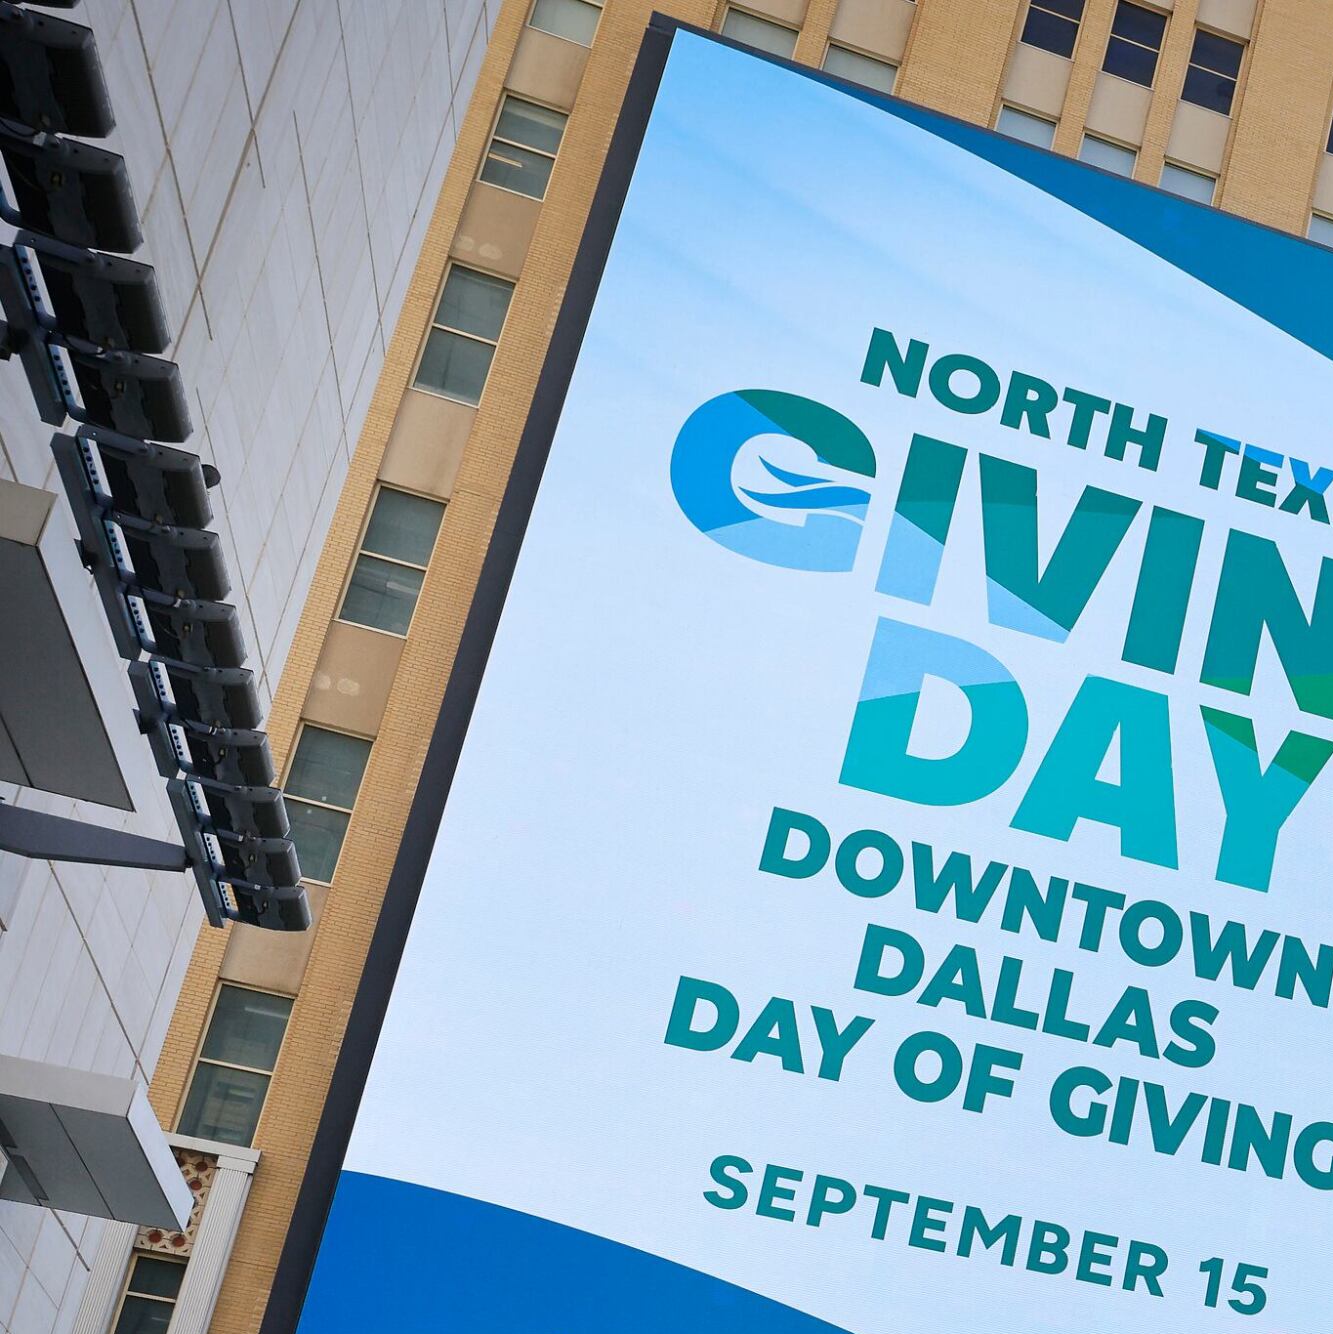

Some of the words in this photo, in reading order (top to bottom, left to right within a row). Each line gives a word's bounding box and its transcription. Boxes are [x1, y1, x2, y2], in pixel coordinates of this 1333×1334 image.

[860, 327, 1168, 471] NORTH
[663, 975, 876, 1082] DAY
[893, 1031, 1025, 1113] OF
[853, 923, 1220, 1068] DALLAS
[703, 1154, 1170, 1298] SEPTEMBER
[1198, 1256, 1269, 1315] 15
